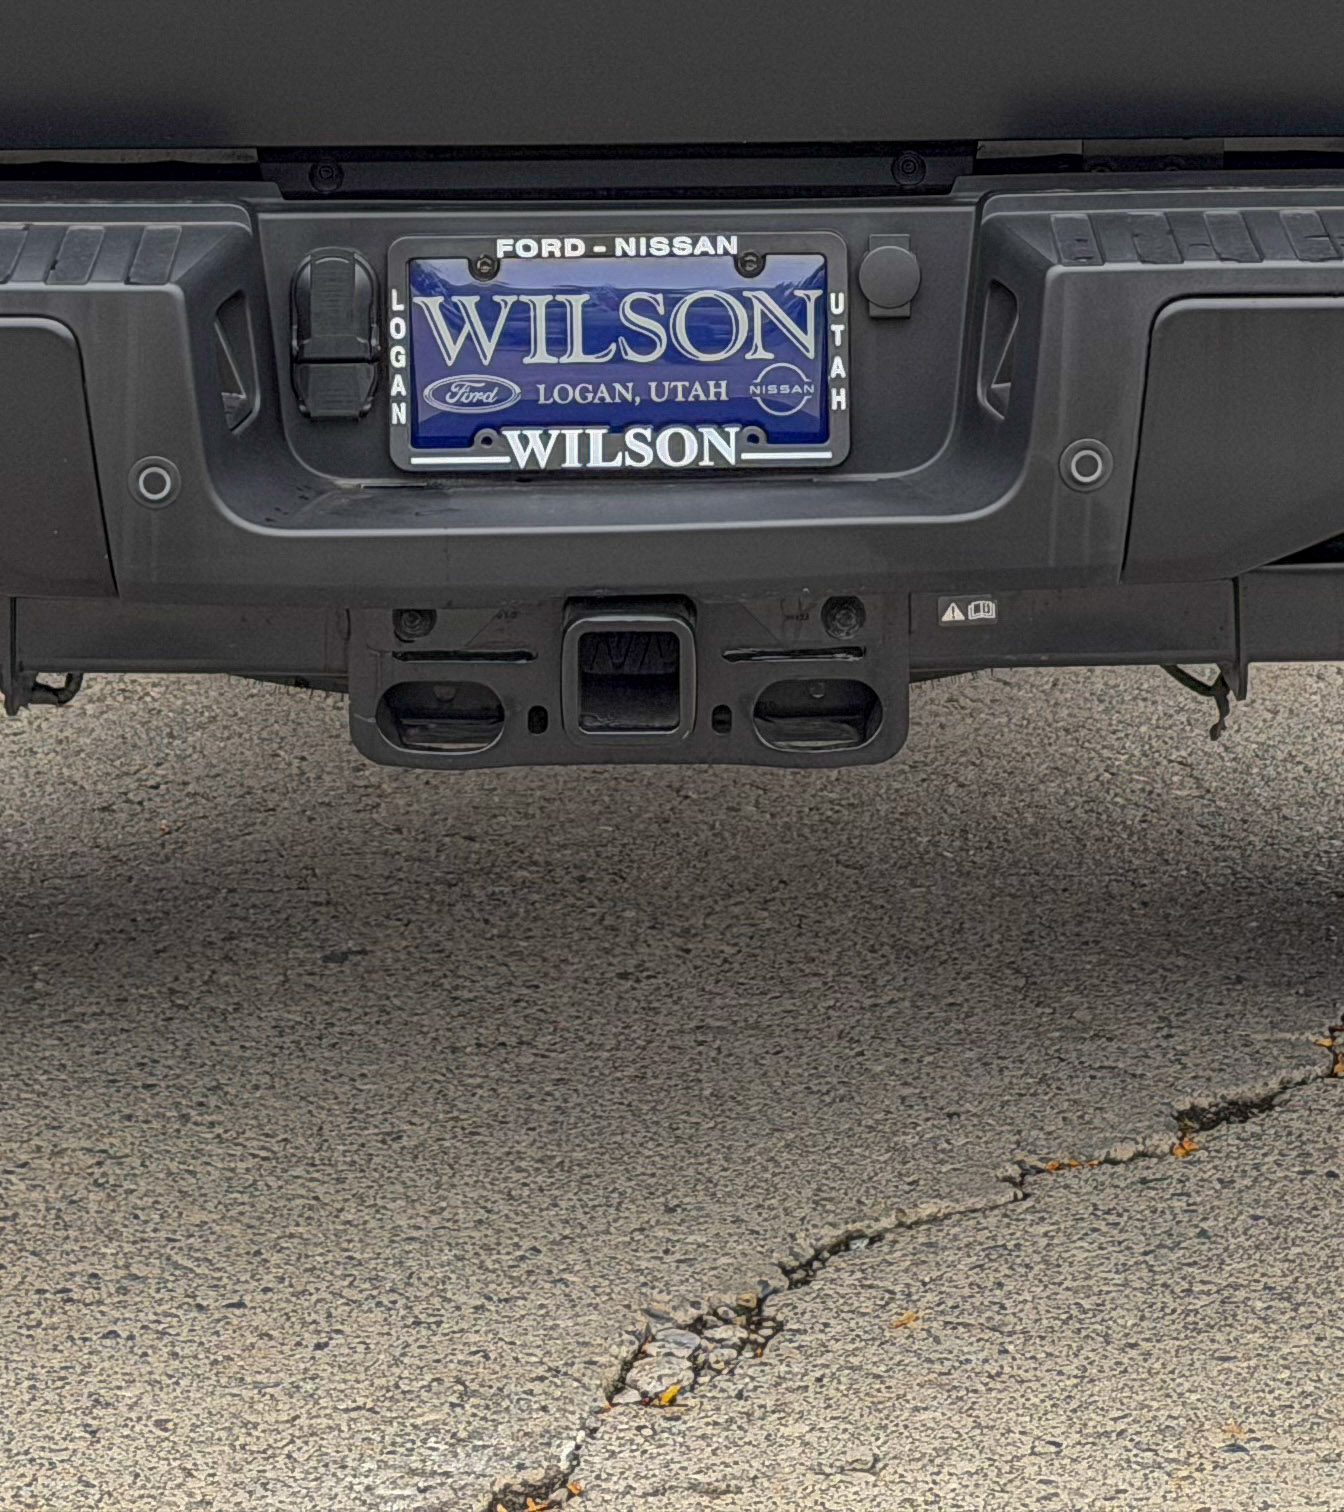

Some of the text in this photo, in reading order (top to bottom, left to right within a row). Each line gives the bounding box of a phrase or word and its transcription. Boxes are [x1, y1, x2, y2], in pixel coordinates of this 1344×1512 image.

[495, 238, 586, 259] FORD
[614, 235, 739, 257] NISSAN
[412, 289, 824, 367] WILSON
[389, 288, 407, 425] LOGAN
[829, 291, 847, 411] UTAH
[444, 380, 499, 405] Ford
[536, 379, 730, 407] LOGAN, UTAH
[748, 383, 815, 395] NISSAN
[501, 425, 741, 470] WILSON
